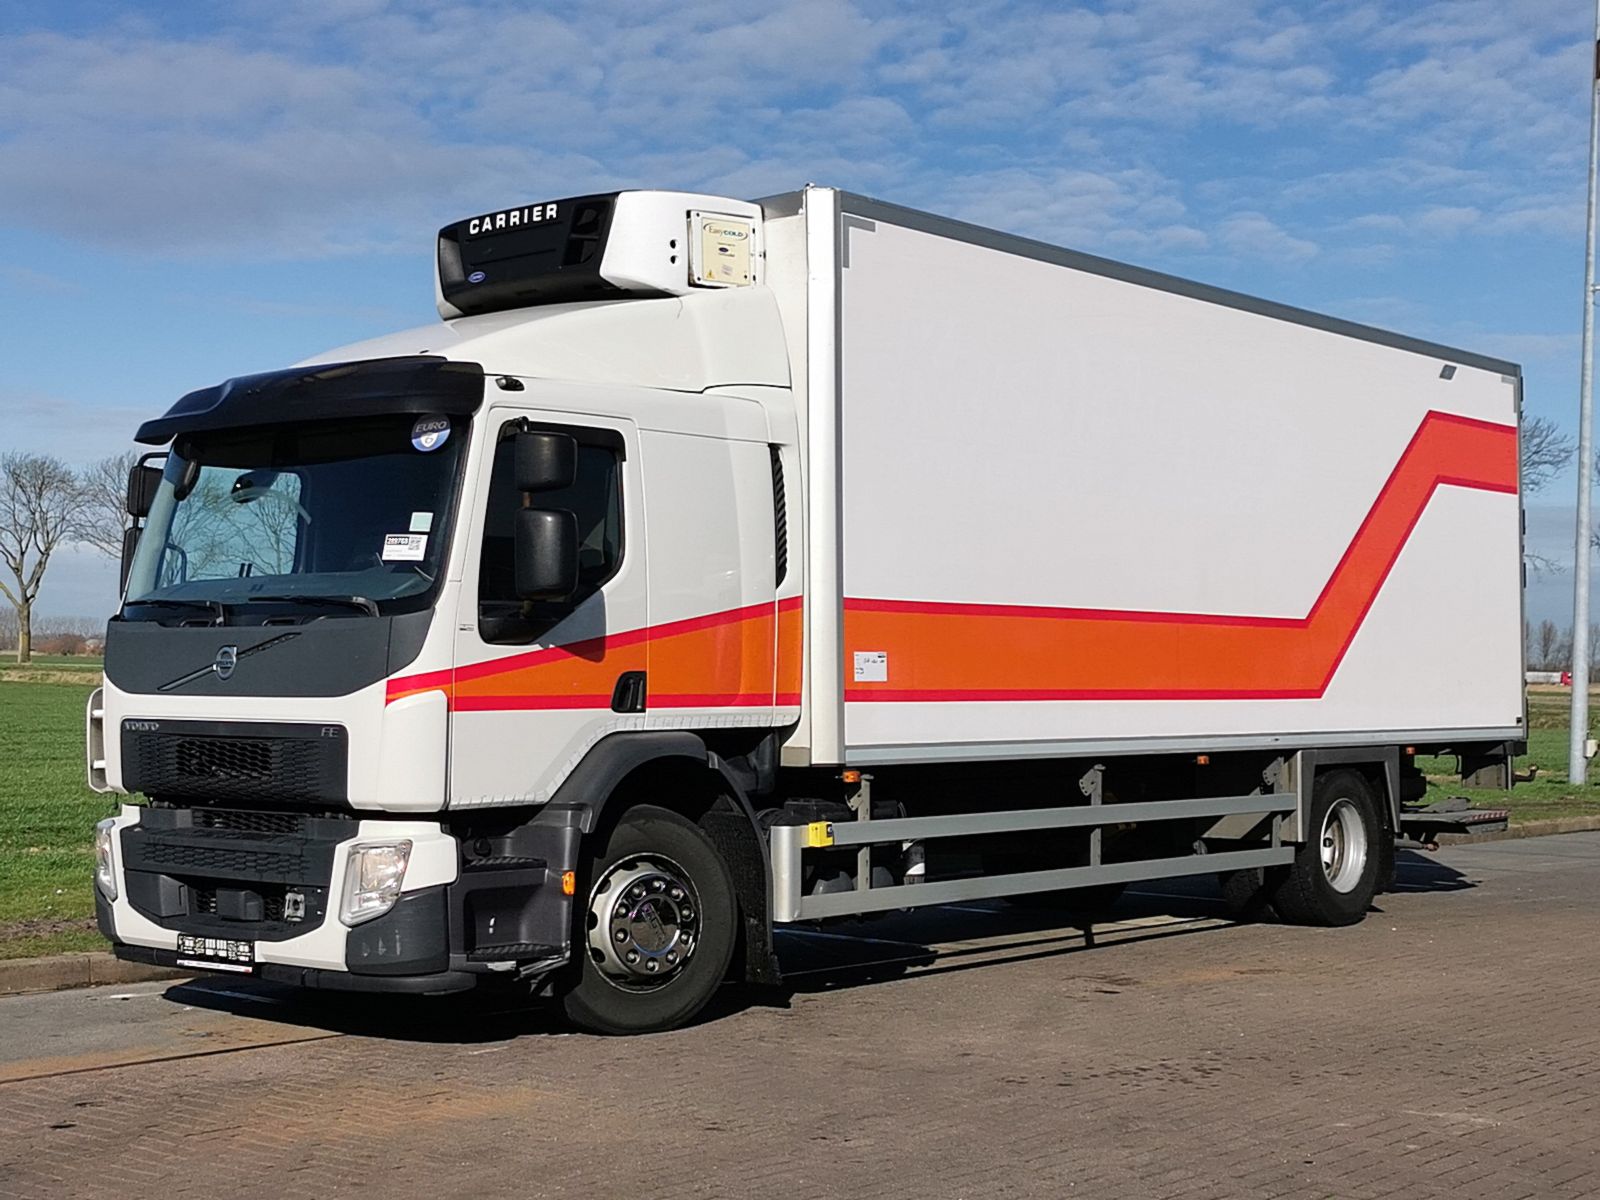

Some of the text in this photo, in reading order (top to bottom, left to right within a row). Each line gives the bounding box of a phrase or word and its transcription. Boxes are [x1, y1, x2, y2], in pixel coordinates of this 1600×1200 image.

[469, 203, 557, 234] CARRIER
[415, 421, 447, 432] EURO
[123, 720, 160, 732] VOLVO
[321, 726, 339, 738] FE
